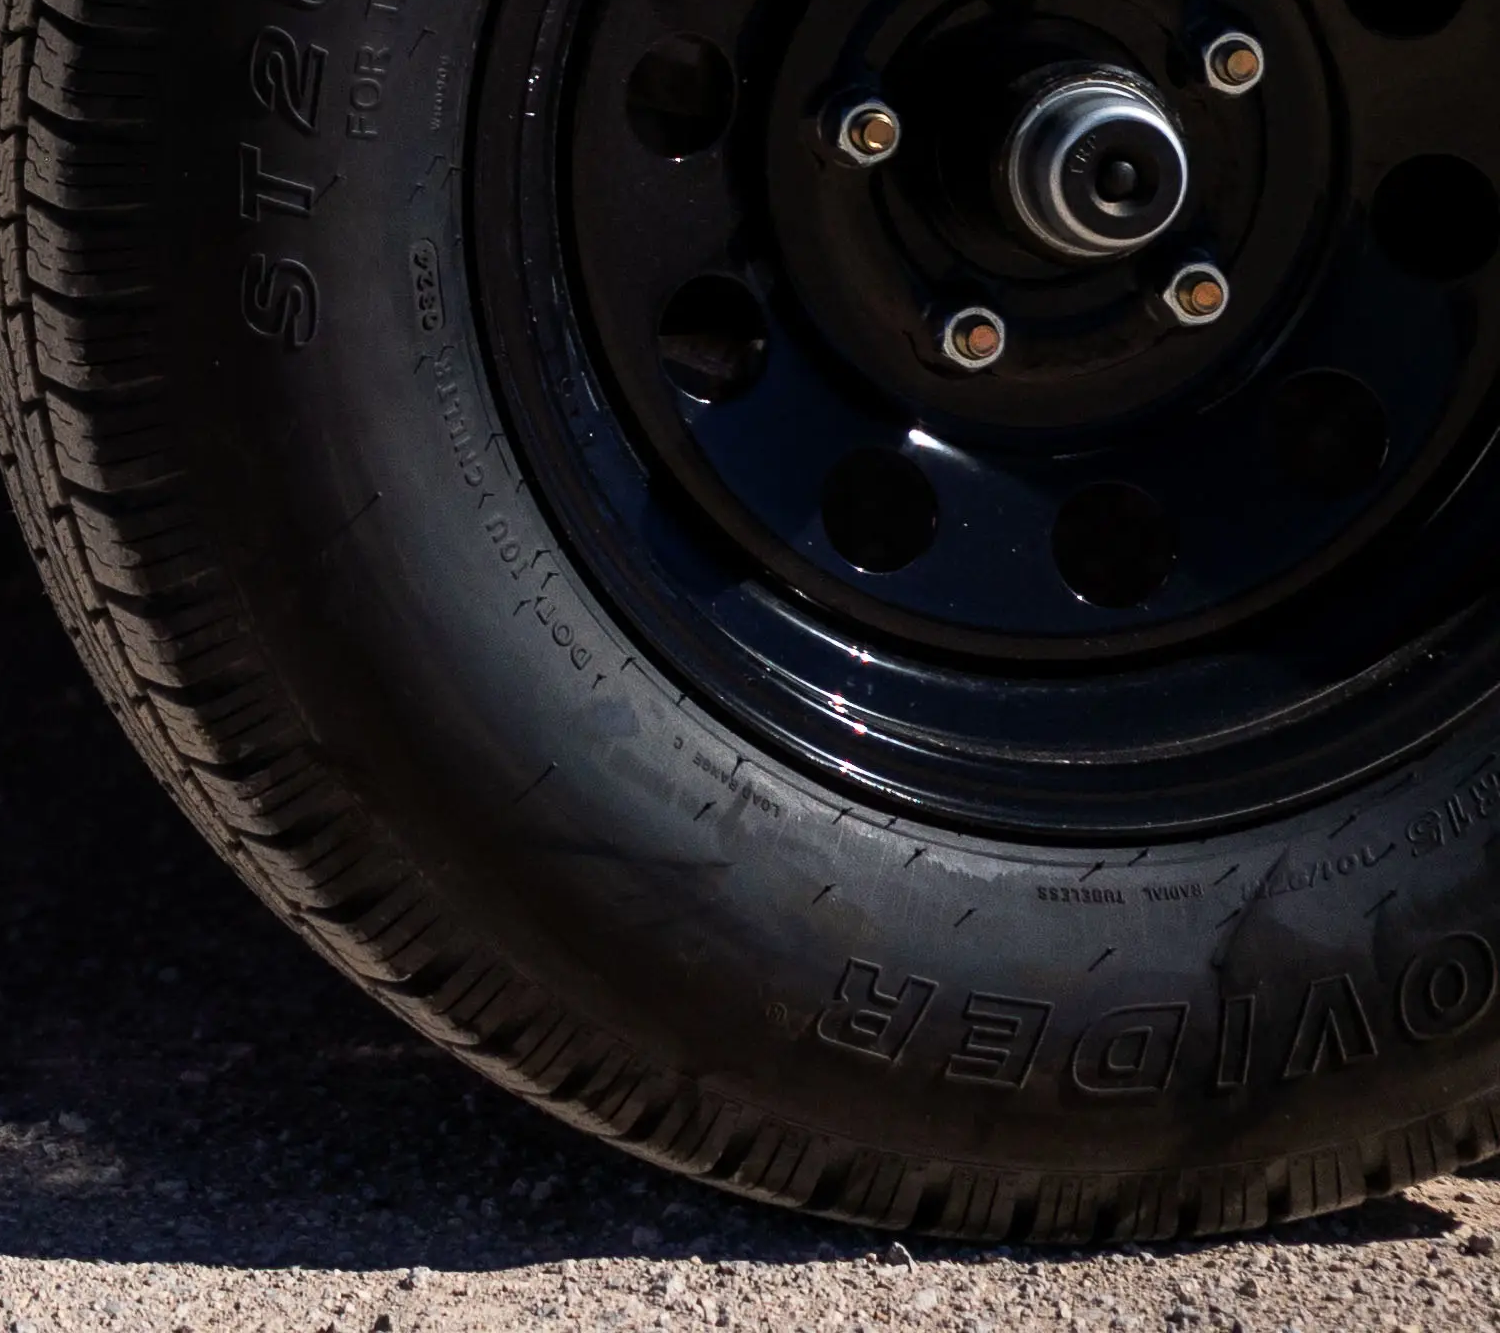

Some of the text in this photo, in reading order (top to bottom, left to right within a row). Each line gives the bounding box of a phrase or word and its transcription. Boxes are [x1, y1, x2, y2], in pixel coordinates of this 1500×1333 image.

[346, 43, 392, 141] FOR
[535, 605, 593, 672] DOT
[740, 785, 780, 818] LOAD
[1036, 883, 1204, 905] RADIAL TUBELESS
